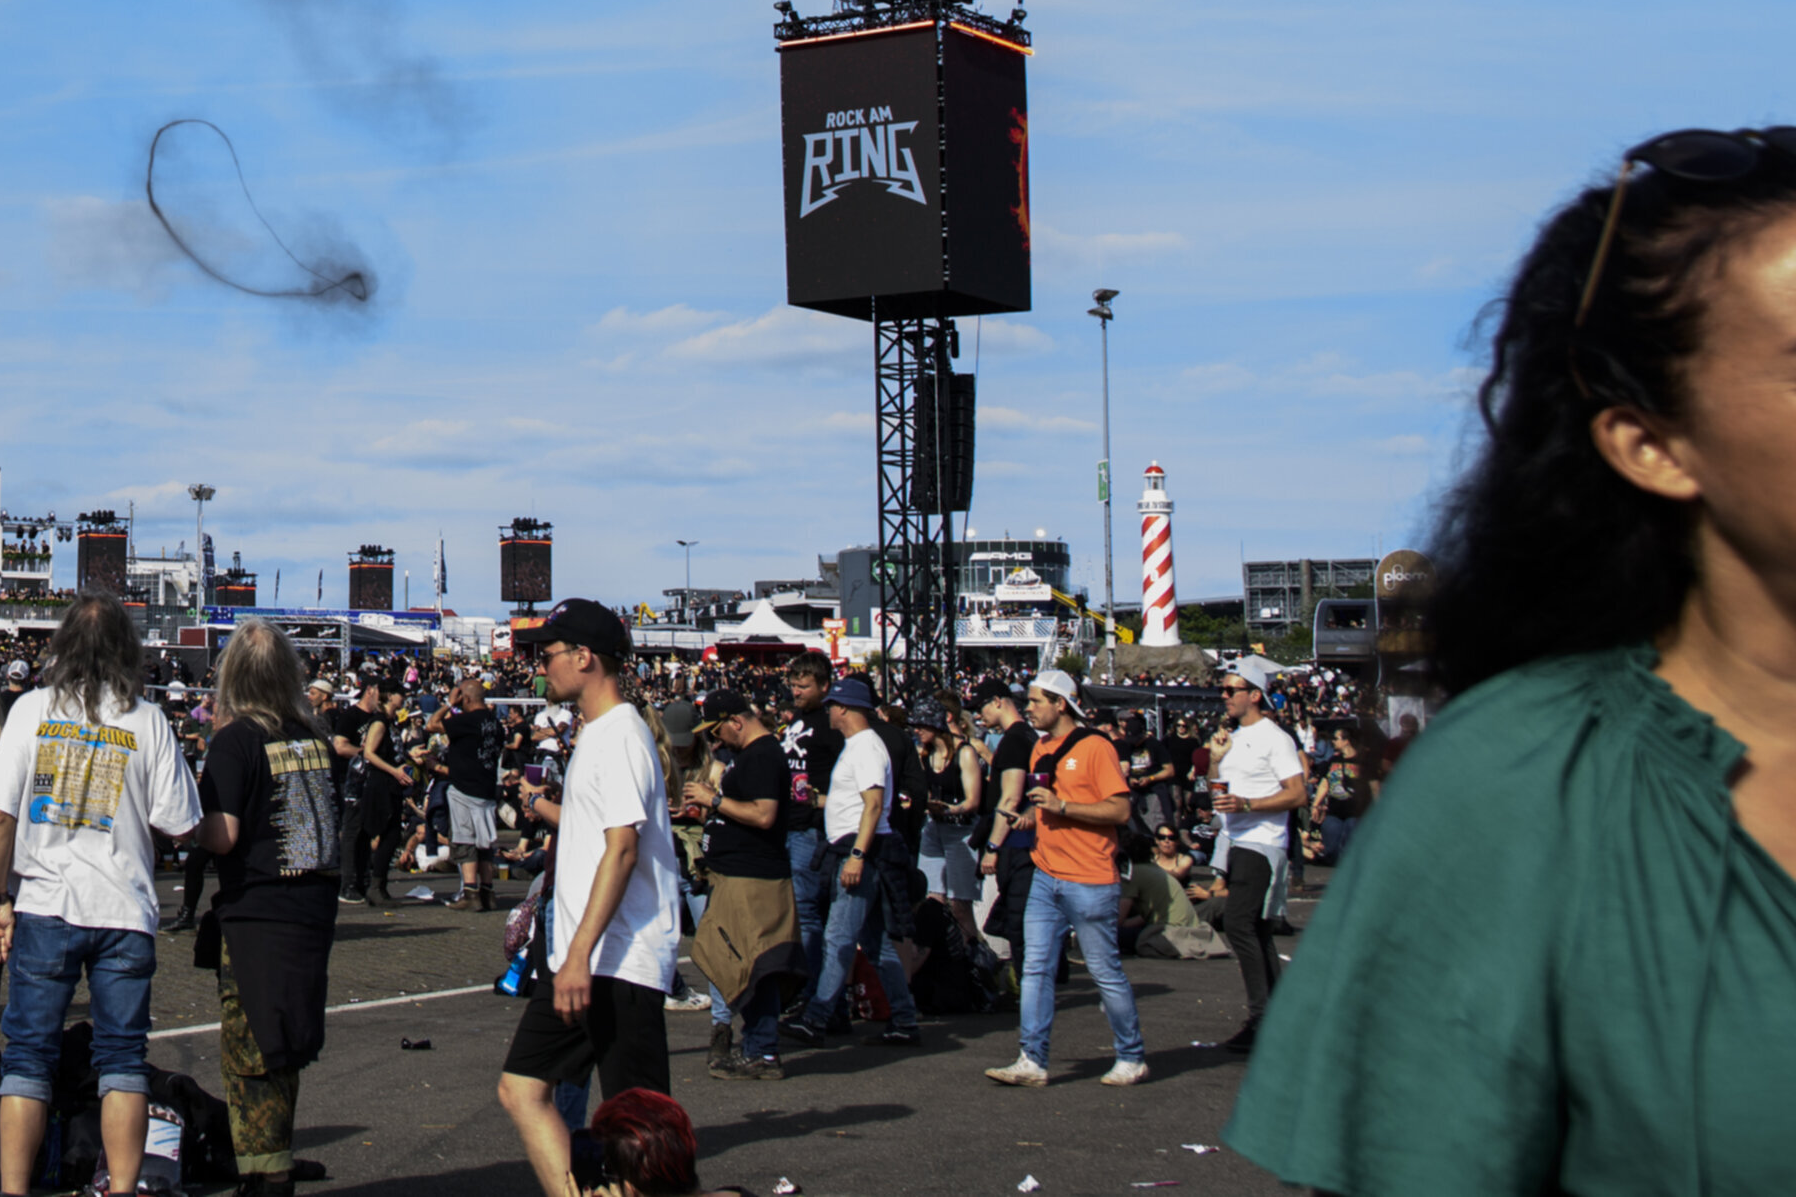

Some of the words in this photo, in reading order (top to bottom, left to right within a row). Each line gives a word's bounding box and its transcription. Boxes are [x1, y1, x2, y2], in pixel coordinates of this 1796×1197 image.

[825, 109, 866, 129] ROCK
[869, 105, 893, 122] AM
[800, 120, 927, 220] RING
[988, 552, 1033, 560] AMG
[1383, 564, 1428, 591] ploom
[36, 721, 82, 740] ROCK
[99, 726, 138, 751] RING
